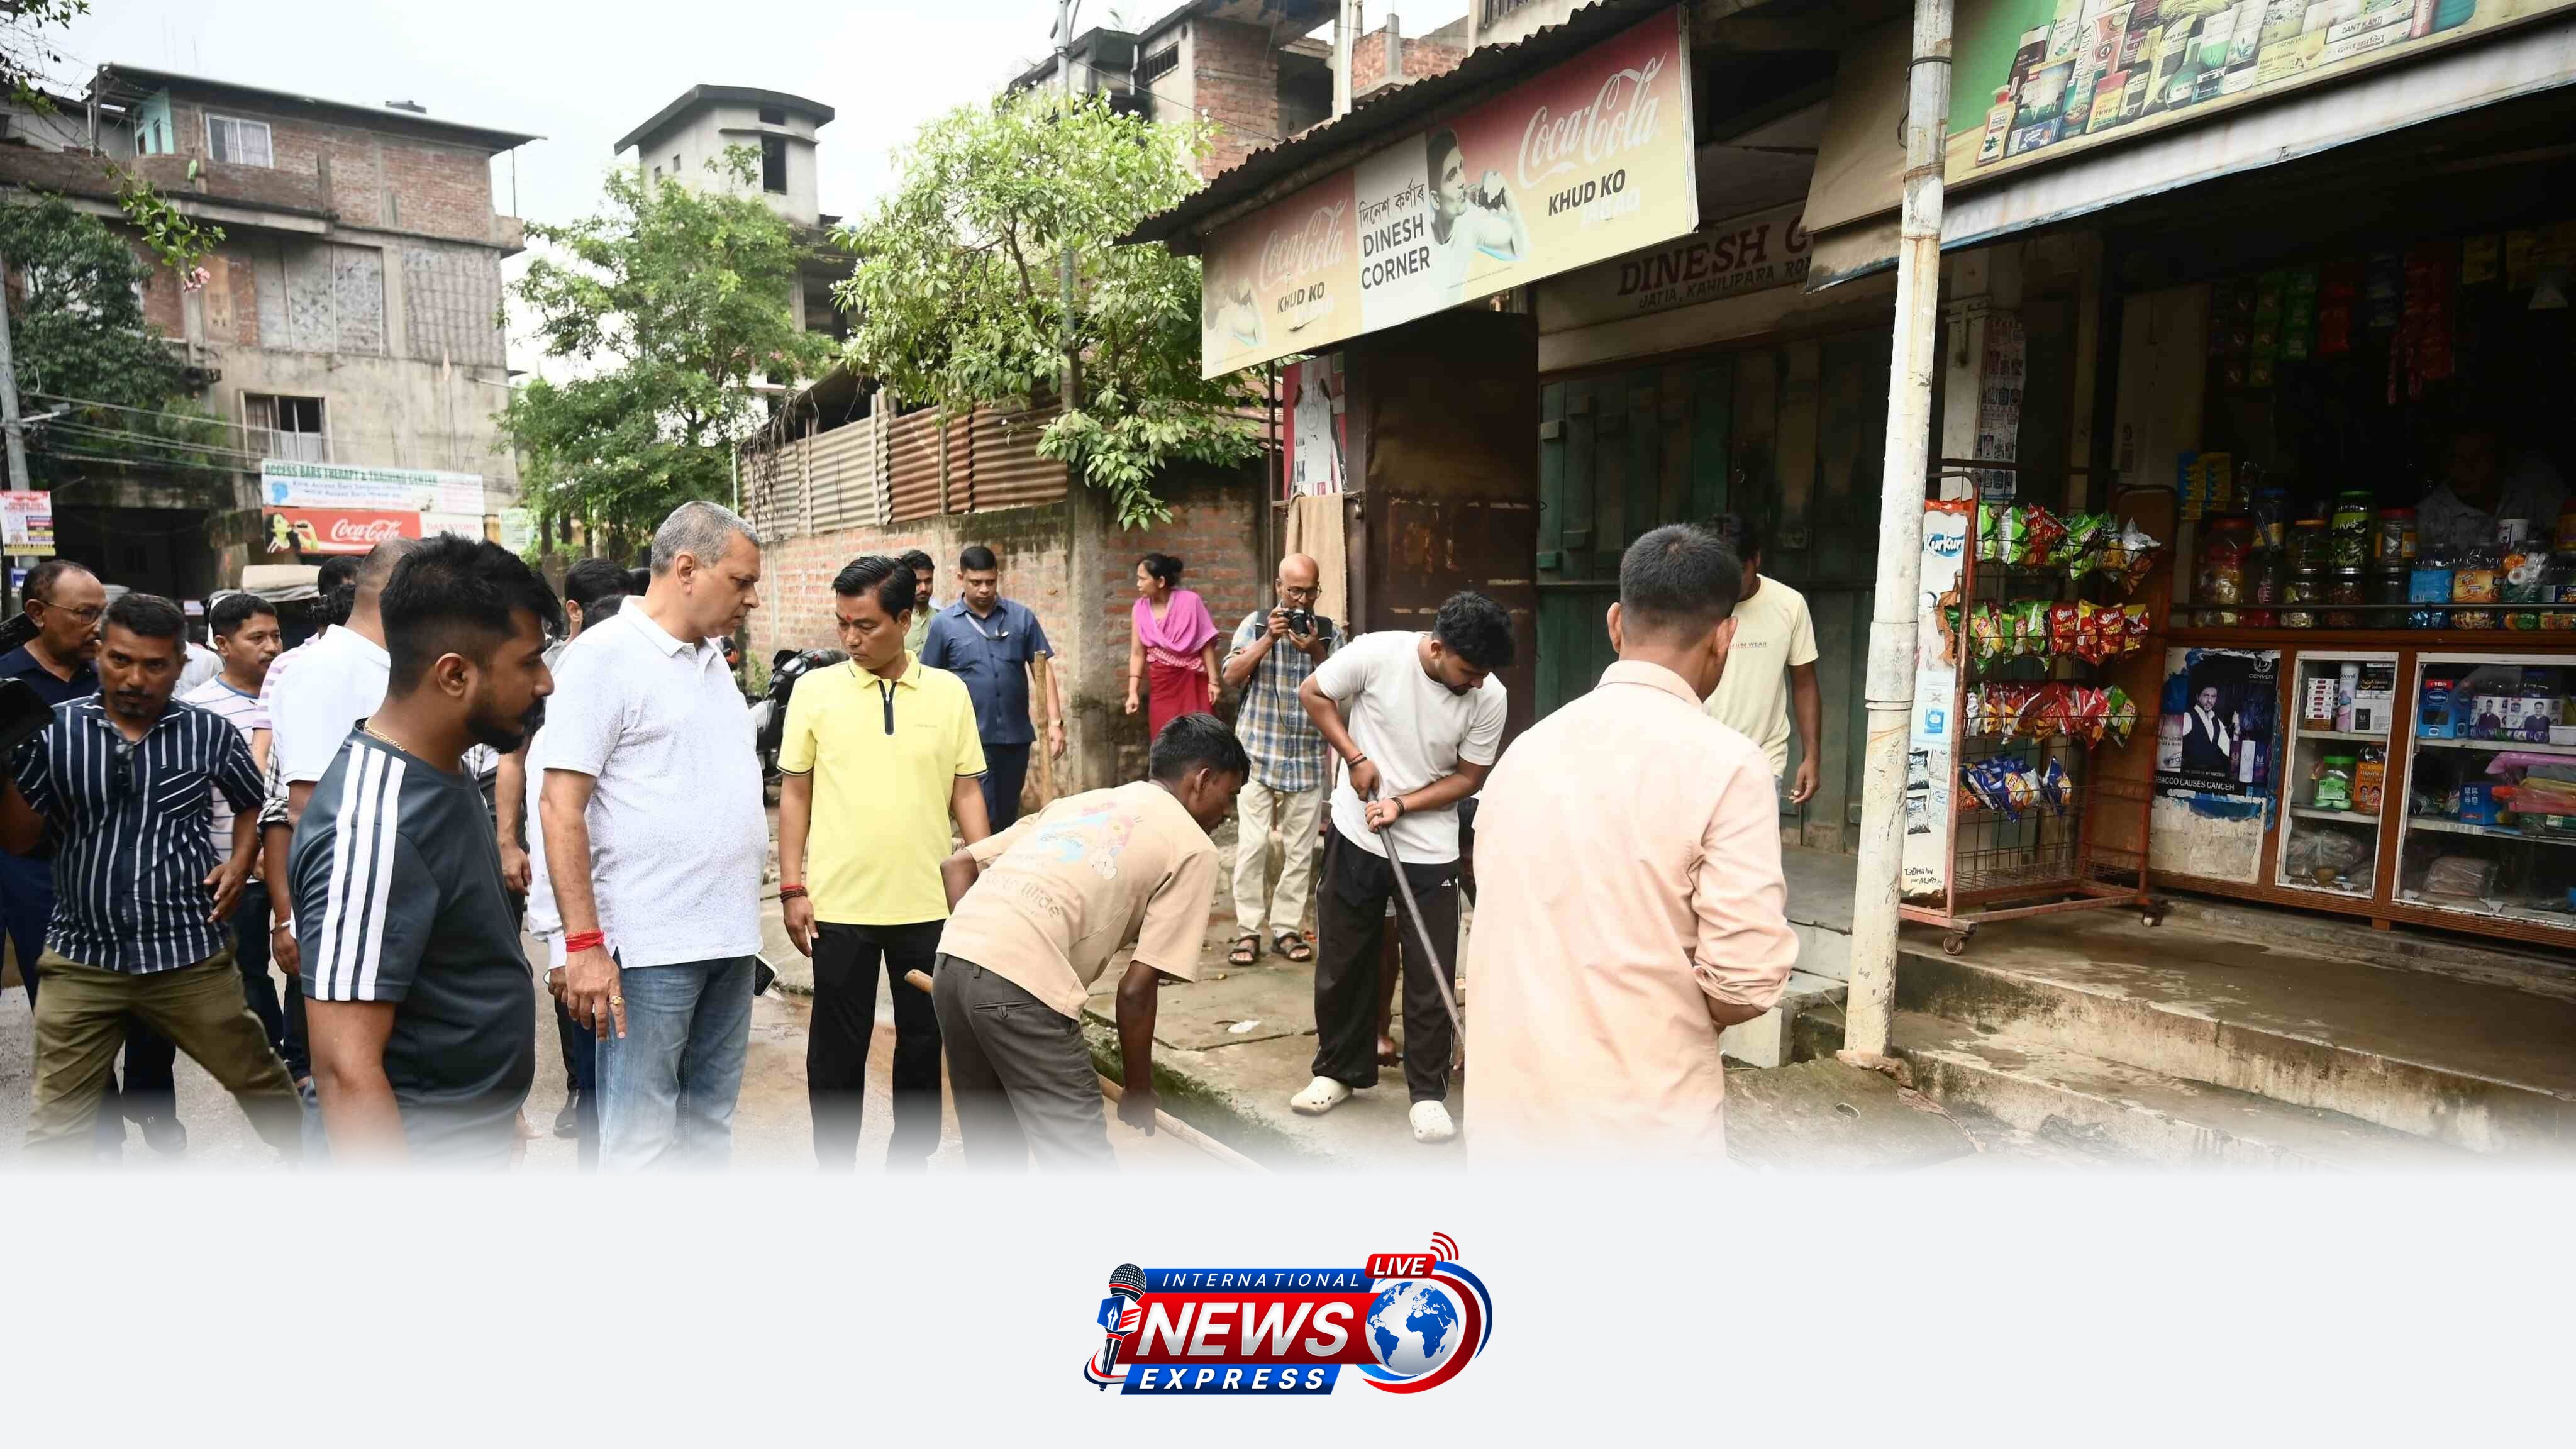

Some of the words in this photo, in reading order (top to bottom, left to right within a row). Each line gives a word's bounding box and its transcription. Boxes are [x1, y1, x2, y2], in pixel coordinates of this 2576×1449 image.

[1517, 50, 1667, 189] Coca-Cola
[1548, 180, 1596, 216] KHUD
[1600, 169, 1626, 198] KO
[1259, 196, 1348, 292] Coca-Cola
[1363, 213, 1424, 258] DINESH
[1361, 246, 1430, 290] CORNER
[1618, 224, 1770, 296] DINESH
[1277, 286, 1304, 314] KHUD
[1309, 281, 1326, 303] KO
[265, 464, 297, 477] ACCESS
[331, 518, 402, 541] Coca-Cola
[1923, 532, 1965, 558] Kurkur
[2180, 778, 2206, 788] CAUSES
[2206, 781, 2235, 791] CANCER
